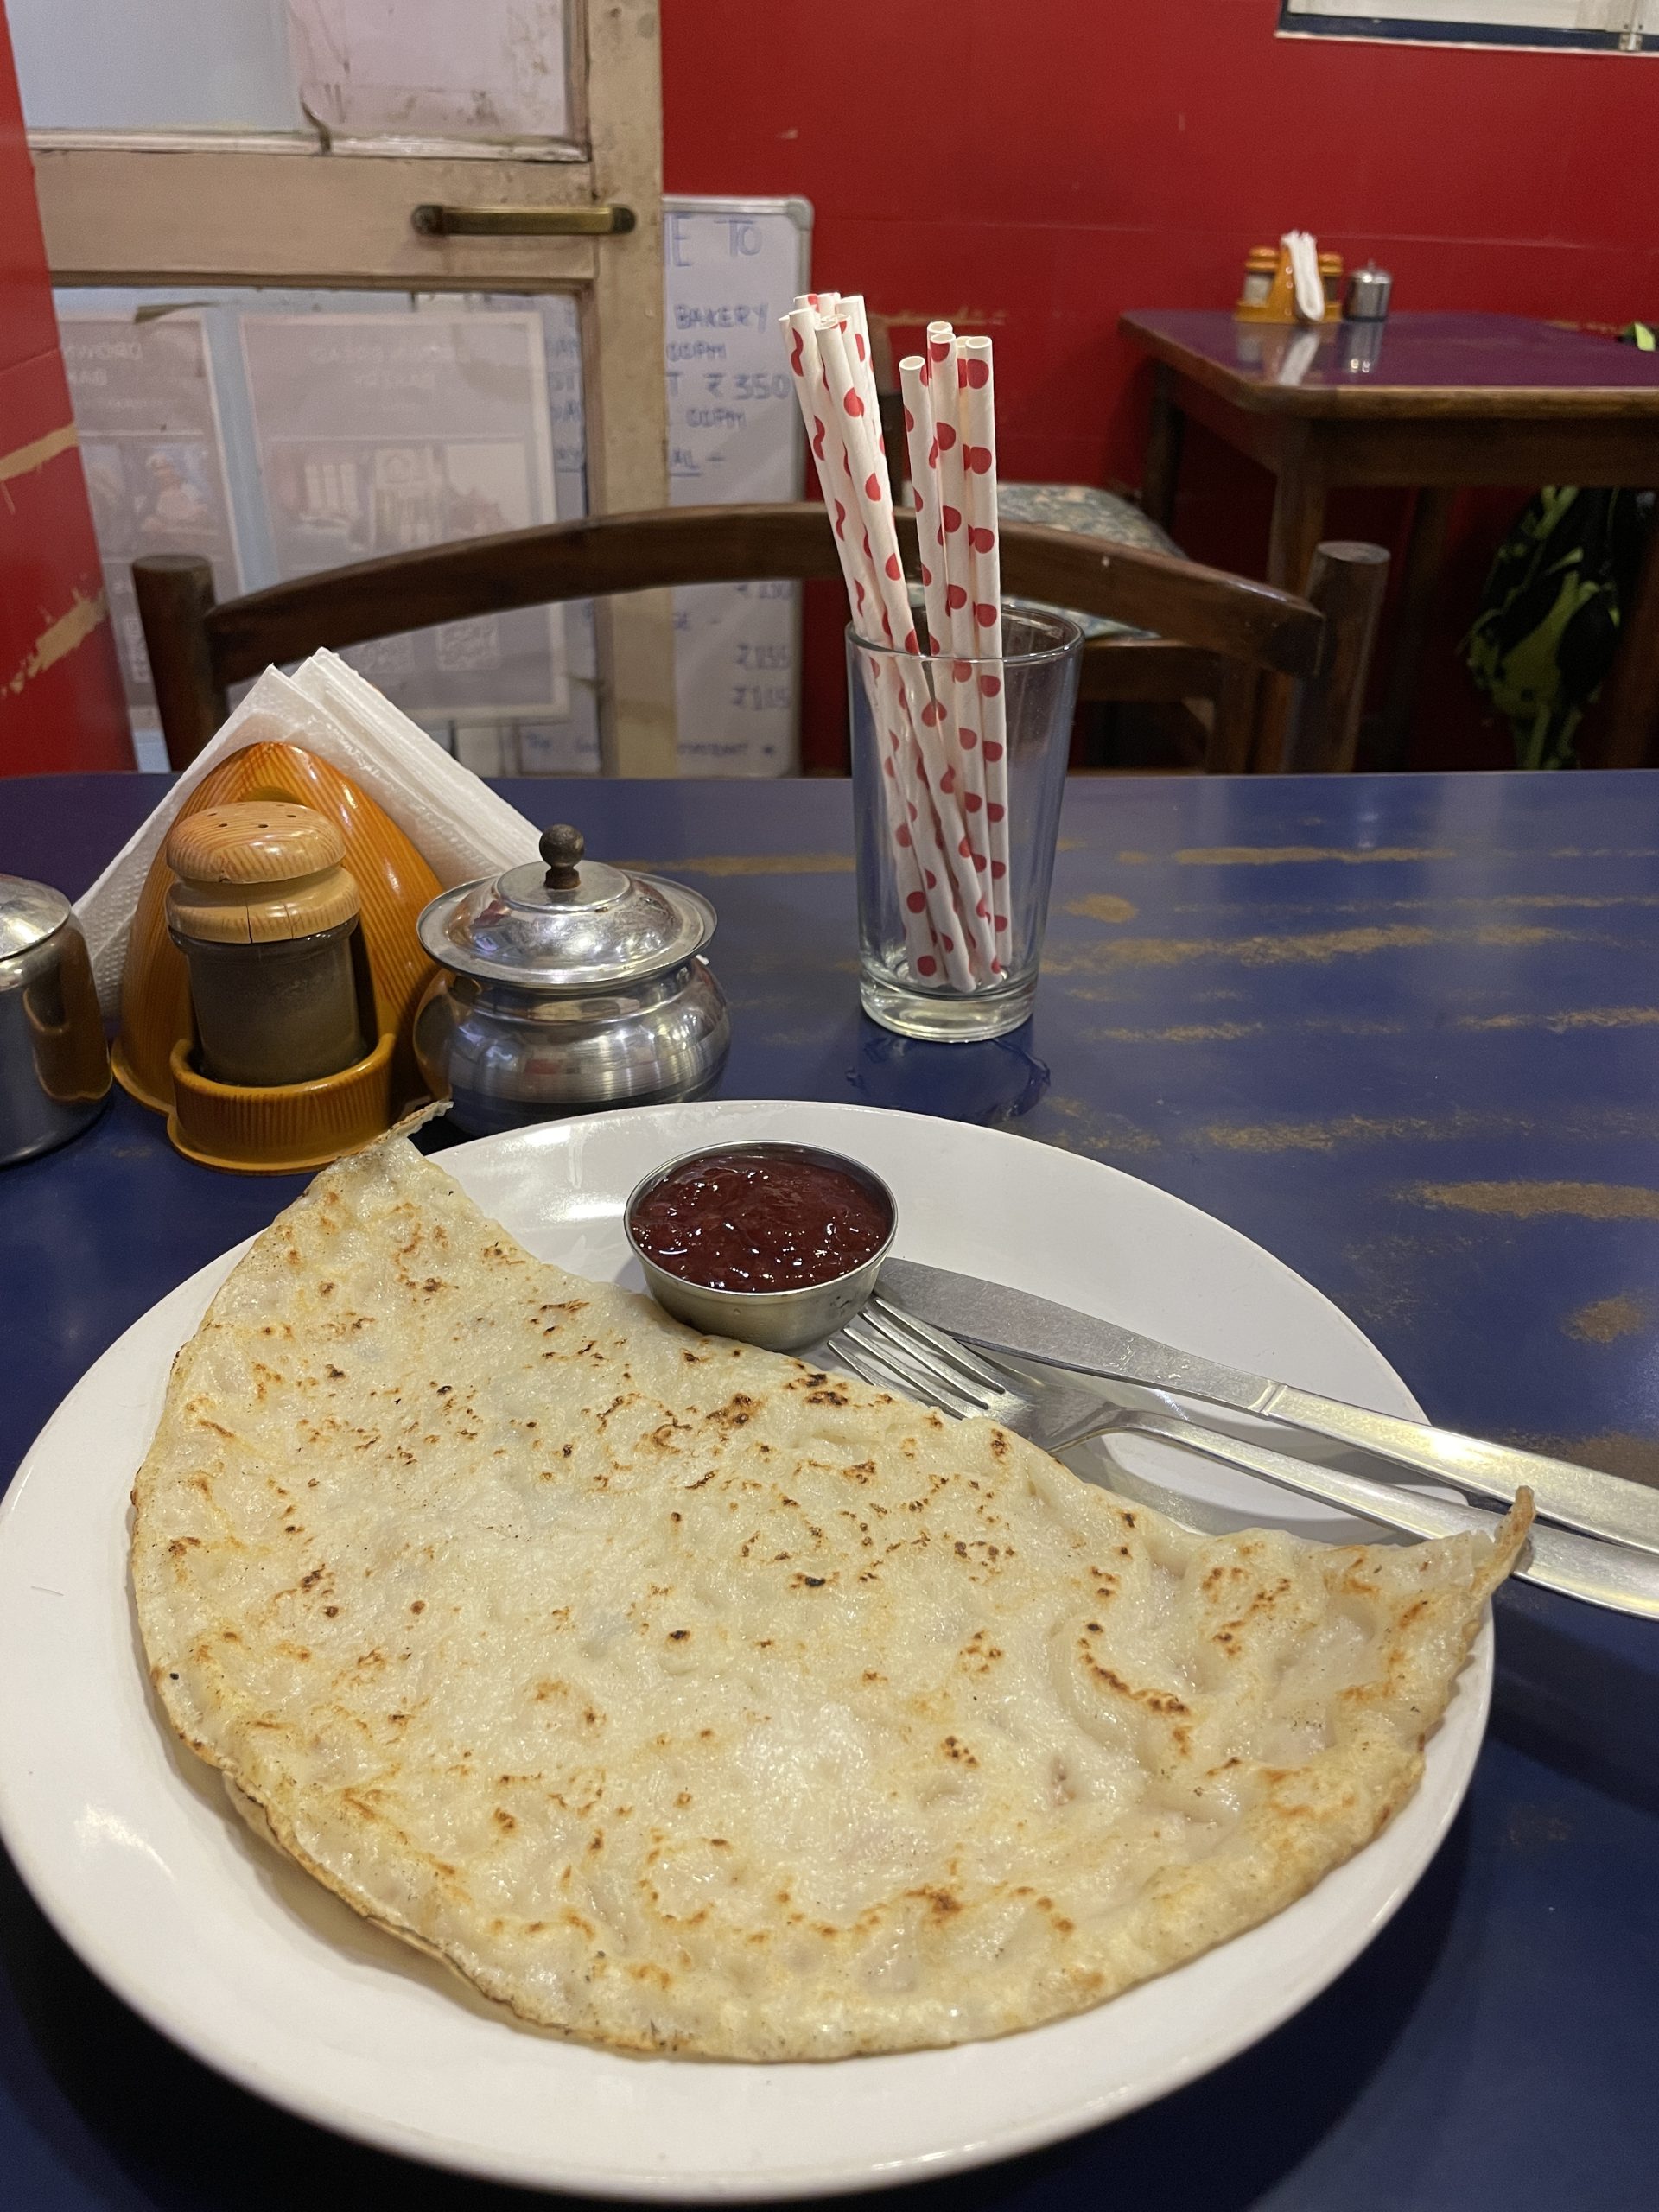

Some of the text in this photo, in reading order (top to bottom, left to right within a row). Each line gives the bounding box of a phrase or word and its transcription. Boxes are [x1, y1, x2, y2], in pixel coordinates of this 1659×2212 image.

[668, 213, 762, 266] E TO
[674, 303, 767, 331] BAKERY
